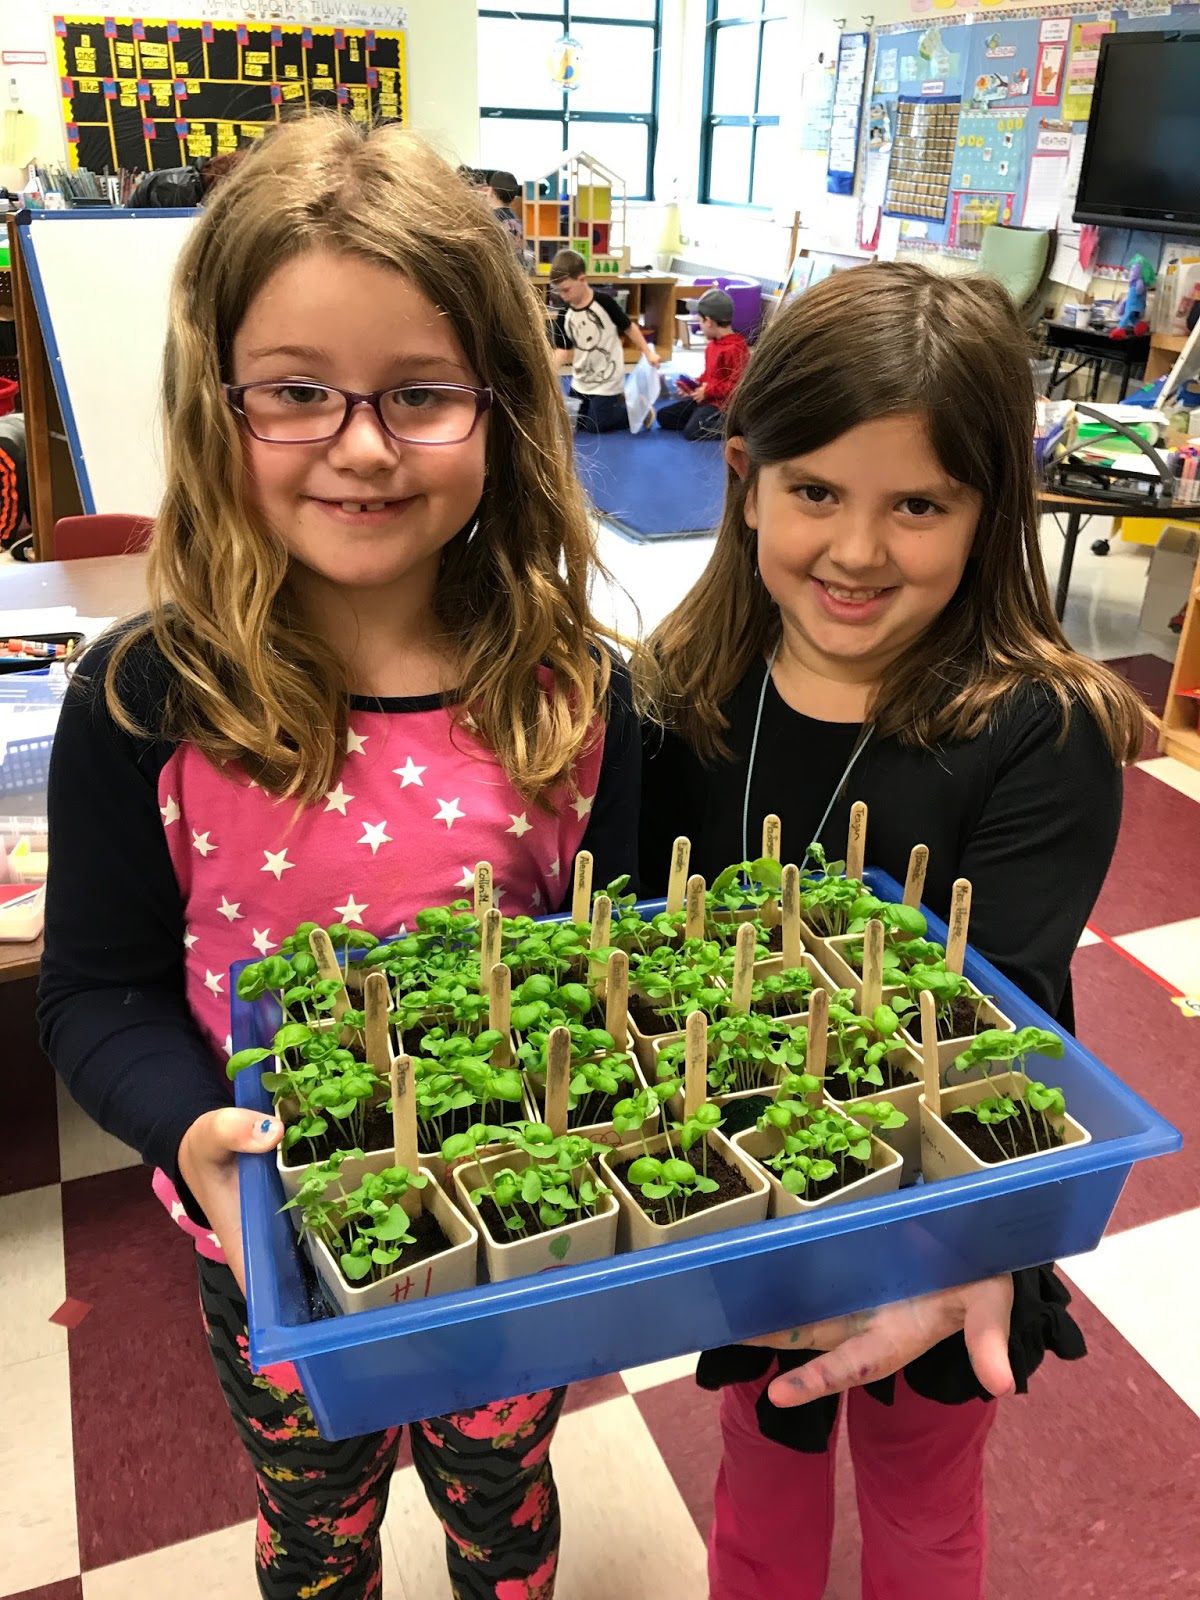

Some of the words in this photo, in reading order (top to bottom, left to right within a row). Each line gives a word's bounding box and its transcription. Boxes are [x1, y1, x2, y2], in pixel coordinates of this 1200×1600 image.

[133, 22, 145, 34] C
[167, 24, 179, 38] D
[77, 50, 96, 60] and
[246, 52, 269, 62] from
[78, 62, 95, 70] are
[176, 62, 188, 74] do
[80, 81, 99, 92] like
[174, 82, 186, 95] O
[144, 123, 155, 134] V
[851, 807, 866, 842] Teagan
[478, 867, 491, 894] Collin
[954, 884, 969, 907] Mrs.
